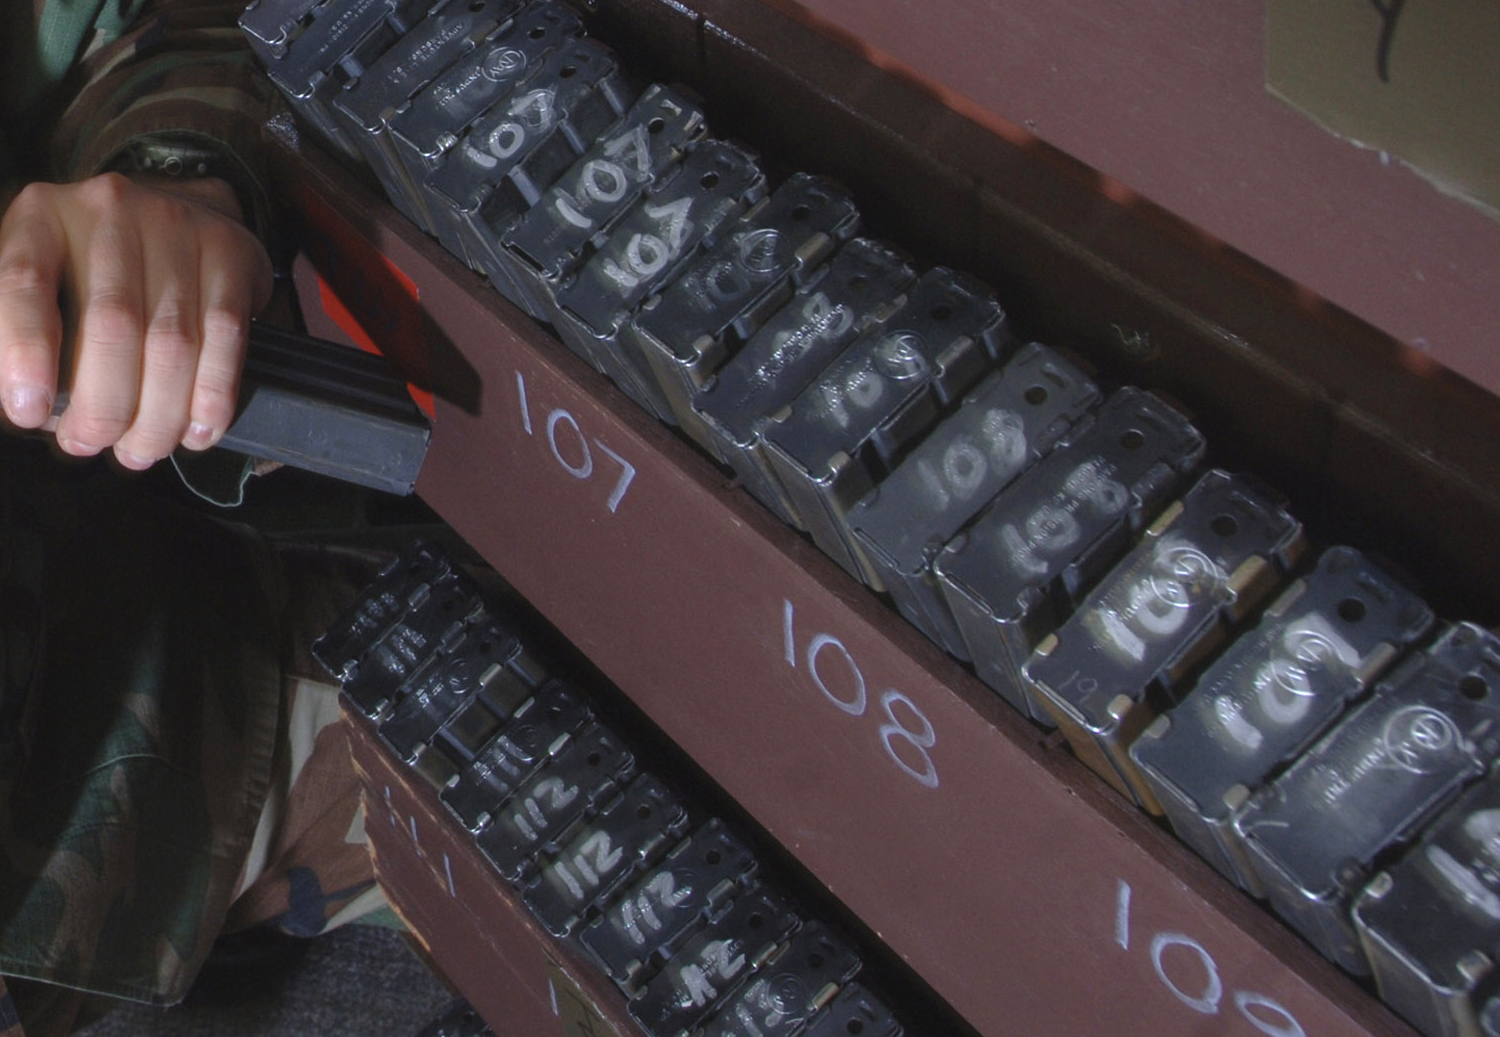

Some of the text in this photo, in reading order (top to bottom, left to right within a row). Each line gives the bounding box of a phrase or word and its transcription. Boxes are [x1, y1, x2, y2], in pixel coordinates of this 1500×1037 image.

[462, 86, 559, 169] 107
[555, 124, 651, 229] 107
[602, 196, 695, 288] 107
[516, 369, 636, 513] 107
[783, 598, 938, 788] 108
[512, 775, 578, 841] 112
[552, 830, 623, 900] 112
[619, 870, 692, 945] 112
